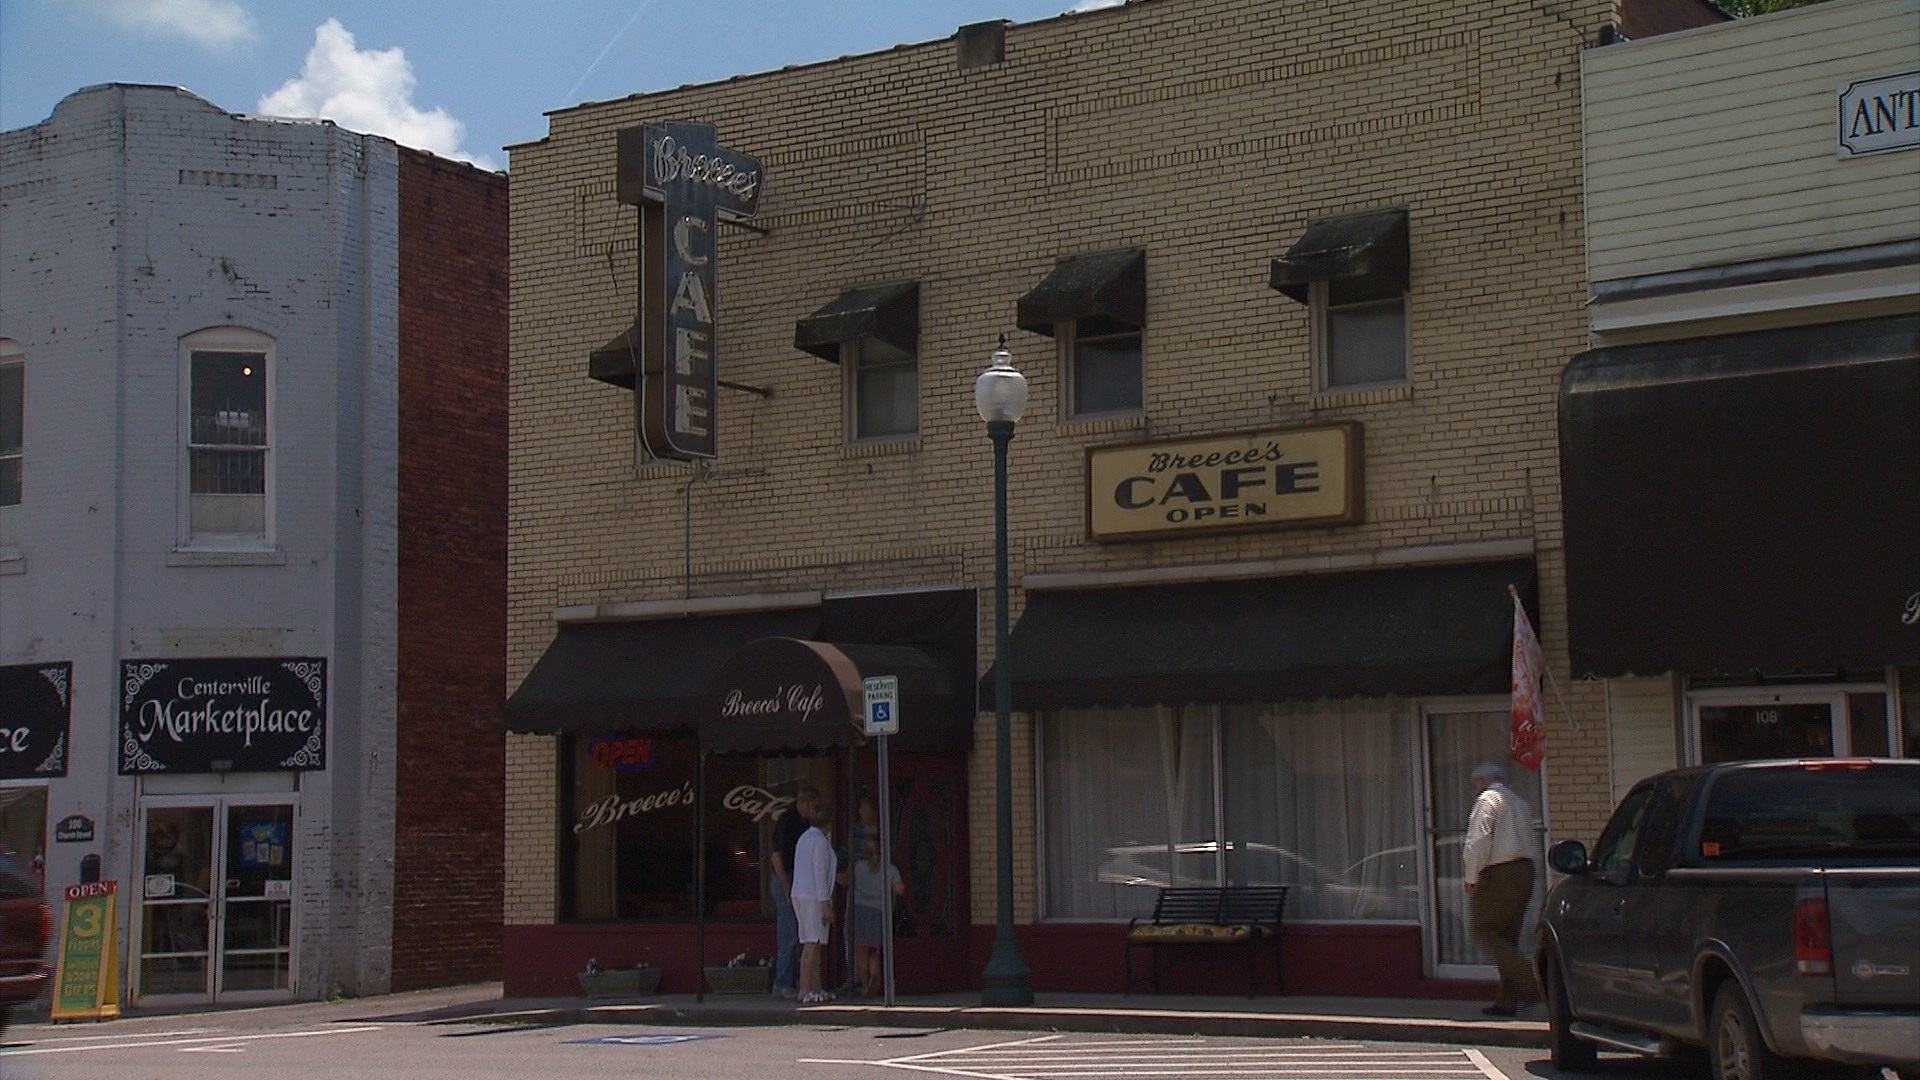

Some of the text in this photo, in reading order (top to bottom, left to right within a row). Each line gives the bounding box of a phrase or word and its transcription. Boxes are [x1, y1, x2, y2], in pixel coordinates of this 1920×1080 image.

[670, 215, 714, 437] CAFE
[1148, 441, 1284, 473] Breece's
[1113, 461, 1320, 510] CAFE
[1166, 503, 1267, 523] OPEN
[177, 676, 271, 699] Centerville
[865, 682, 894, 691] RESERVED
[867, 691, 894, 701] PARKING
[786, 684, 824, 722] Cafe
[1756, 710, 1778, 724] 108
[139, 699, 312, 748] Marketplace
[593, 737, 651, 769] OPEN
[573, 780, 694, 833] Breece's
[69, 881, 108, 898] OPEN
[73, 904, 101, 938] 3
